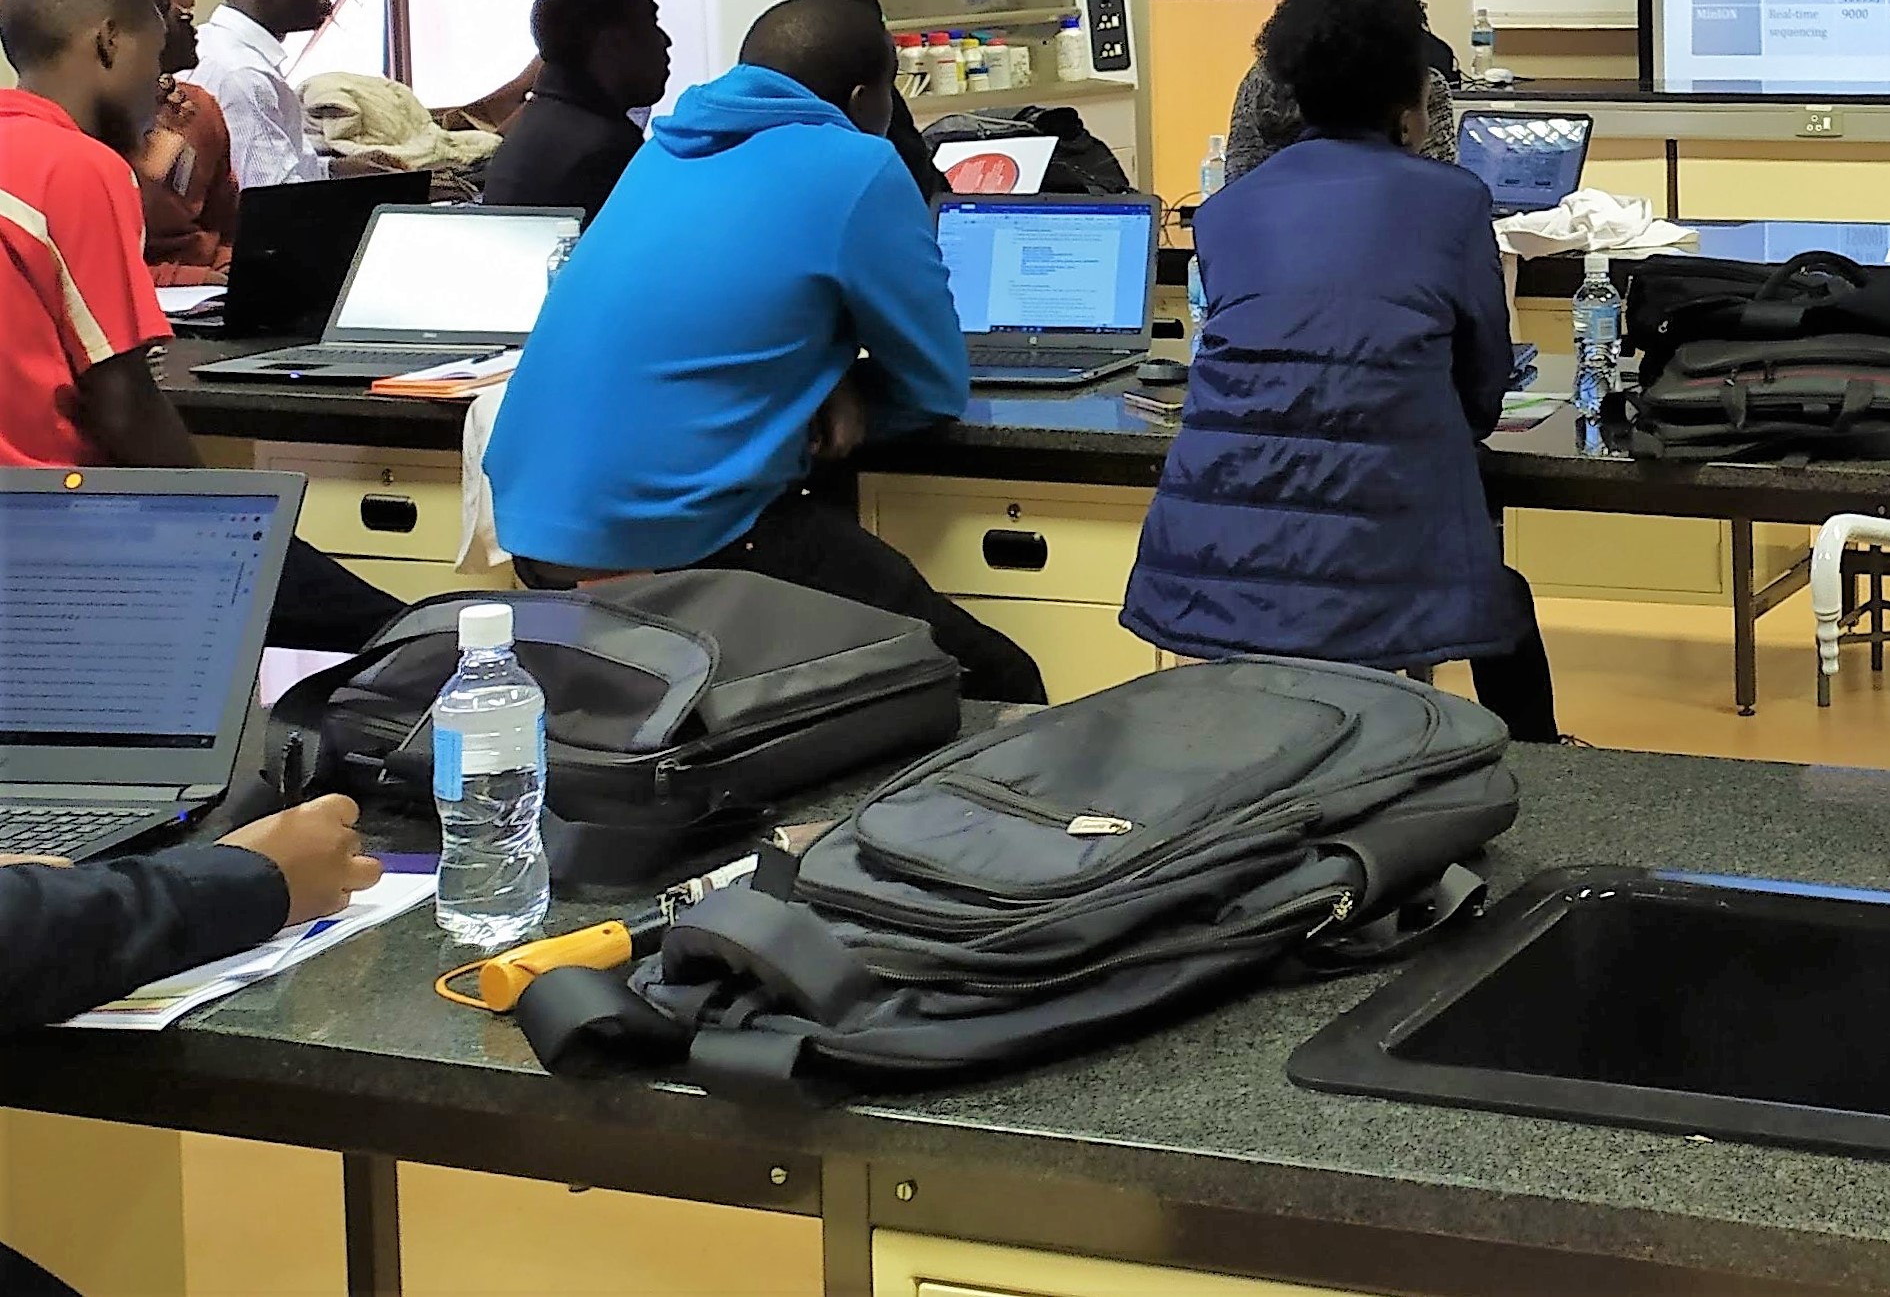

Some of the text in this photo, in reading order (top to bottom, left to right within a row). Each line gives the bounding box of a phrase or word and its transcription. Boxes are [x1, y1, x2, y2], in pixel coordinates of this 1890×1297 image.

[1769, 8, 1819, 20] Real-time
[1841, 8, 1869, 20] 9000
[1769, 26, 1828, 40] sequencing
